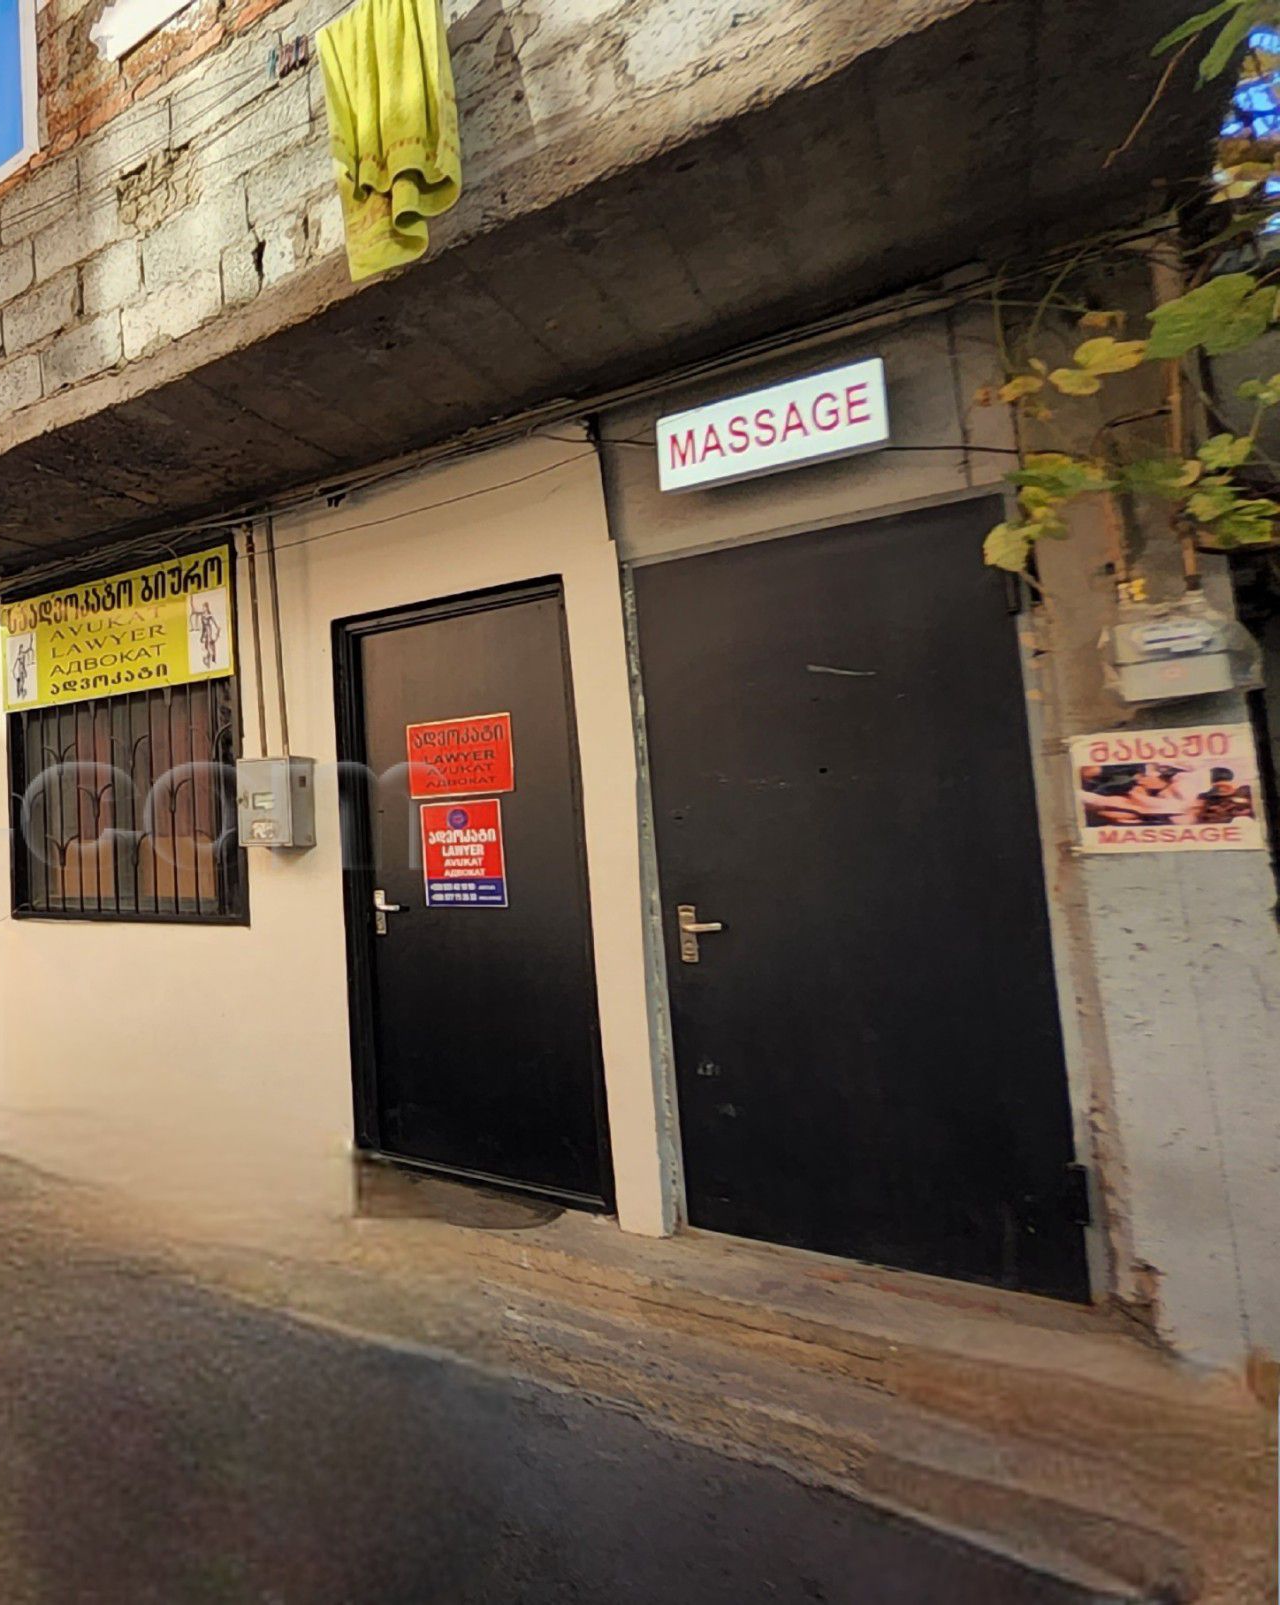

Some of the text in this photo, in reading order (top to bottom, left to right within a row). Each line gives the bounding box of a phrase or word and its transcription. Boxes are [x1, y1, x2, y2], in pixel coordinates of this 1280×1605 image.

[670, 382, 871, 470] MASSAGE
[6, 556, 222, 634] საადვოკატო ბიურო
[50, 603, 165, 642] AVUKAT
[51, 624, 166, 659] LAWYER
[50, 643, 166, 677] АДВОКАТ
[50, 663, 168, 695] ადვოკატი
[414, 724, 503, 749] ადვოკატი
[1090, 732, 1228, 763] მასაჟი
[424, 749, 496, 765] LAWYER
[427, 763, 493, 777] AVUKAT
[441, 844, 485, 857] LAWYER
[1098, 826, 1242, 844] MASSAGE
[443, 857, 484, 867] AVUKAT
